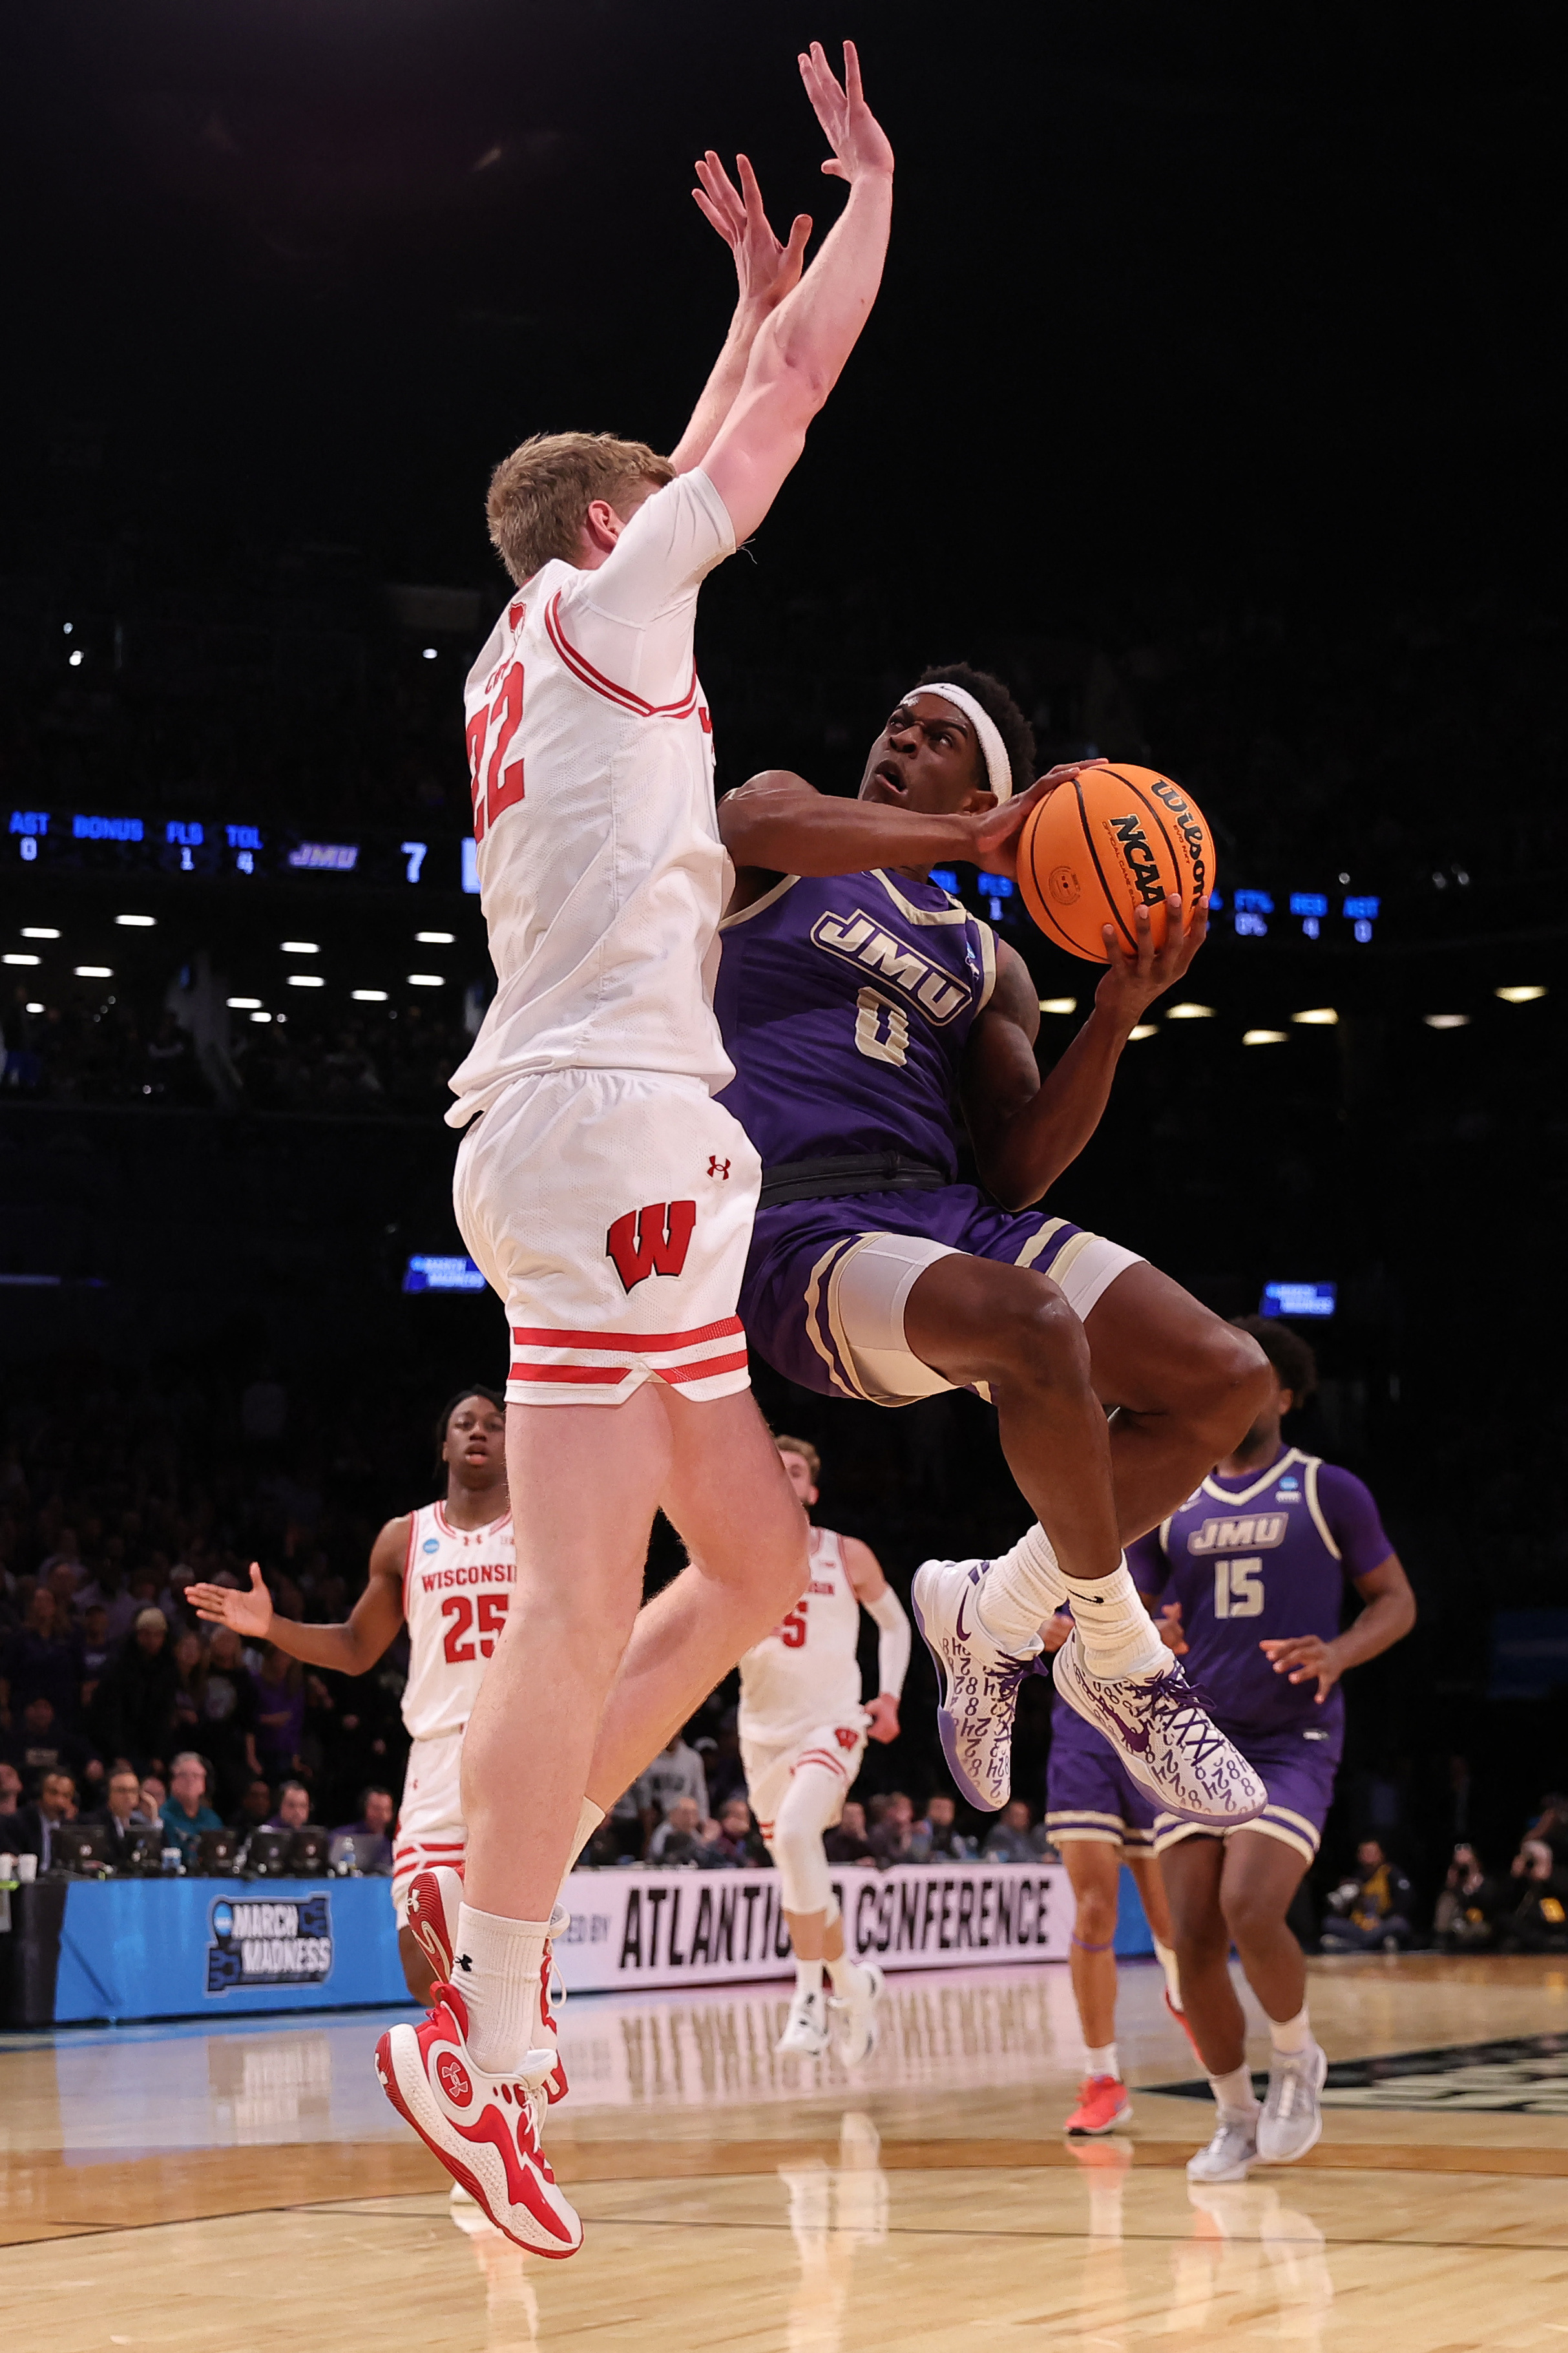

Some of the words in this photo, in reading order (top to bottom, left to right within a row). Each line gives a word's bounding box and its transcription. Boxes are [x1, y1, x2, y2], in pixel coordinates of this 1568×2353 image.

[290, 843, 359, 869] JMU
[401, 842, 427, 883] 7
[1110, 814, 1166, 906] NCAA
[819, 918, 966, 1018] JMU
[855, 986, 910, 1067] 0
[606, 1200, 696, 1295] W
[1193, 1517, 1282, 1550] JMU
[423, 1564, 517, 1592] WISCONSI
[1214, 1556, 1264, 1620] 15
[442, 1594, 509, 1664] 25
[231, 1904, 298, 1939] MARCH
[620, 1884, 791, 1968] ATLANTIC
[856, 1879, 1050, 1955] CONFERENCE
[241, 1937, 331, 1975] MADNESS
